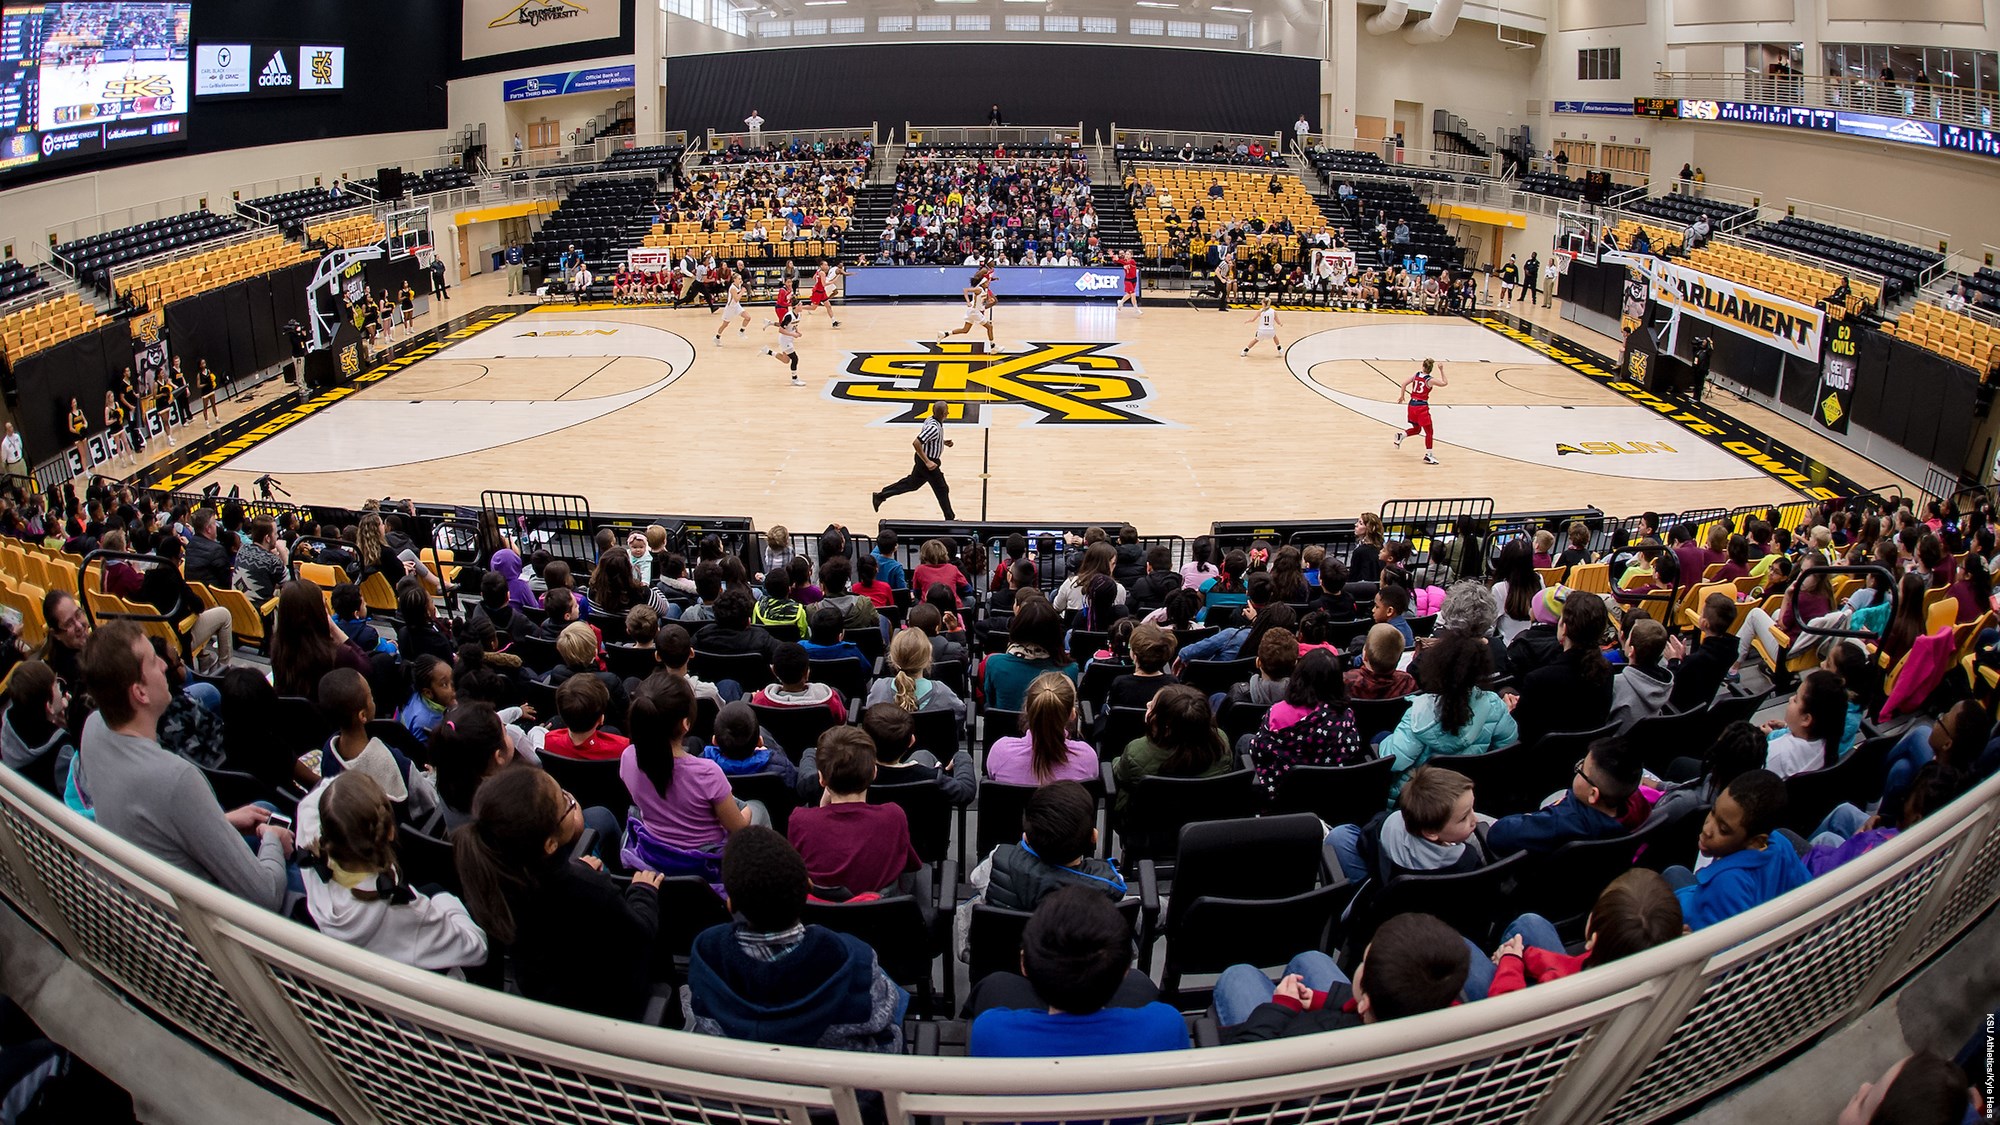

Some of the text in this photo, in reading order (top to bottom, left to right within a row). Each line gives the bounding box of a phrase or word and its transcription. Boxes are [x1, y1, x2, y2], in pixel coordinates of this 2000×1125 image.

[258, 74, 292, 86] adidas
[67, 105, 80, 121] 11
[102, 103, 121, 115] 3:20
[632, 253, 667, 264] ESPN
[344, 261, 362, 279] OWLS
[1264, 315, 1270, 323] 11
[1837, 325, 1851, 340] GO
[1832, 339, 1855, 356] OWLS
[1830, 359, 1842, 374] GET
[1412, 380, 1426, 394] 13
[149, 387, 356, 492] KENNESAW
[353, 341, 454, 382] STATE
[444, 312, 517, 339] OWLS
[1471, 317, 1840, 501] KENNESAW STATE OWLS
[147, 409, 164, 436] 3
[90, 437, 105, 465] 3
[68, 449, 84, 476] 3
